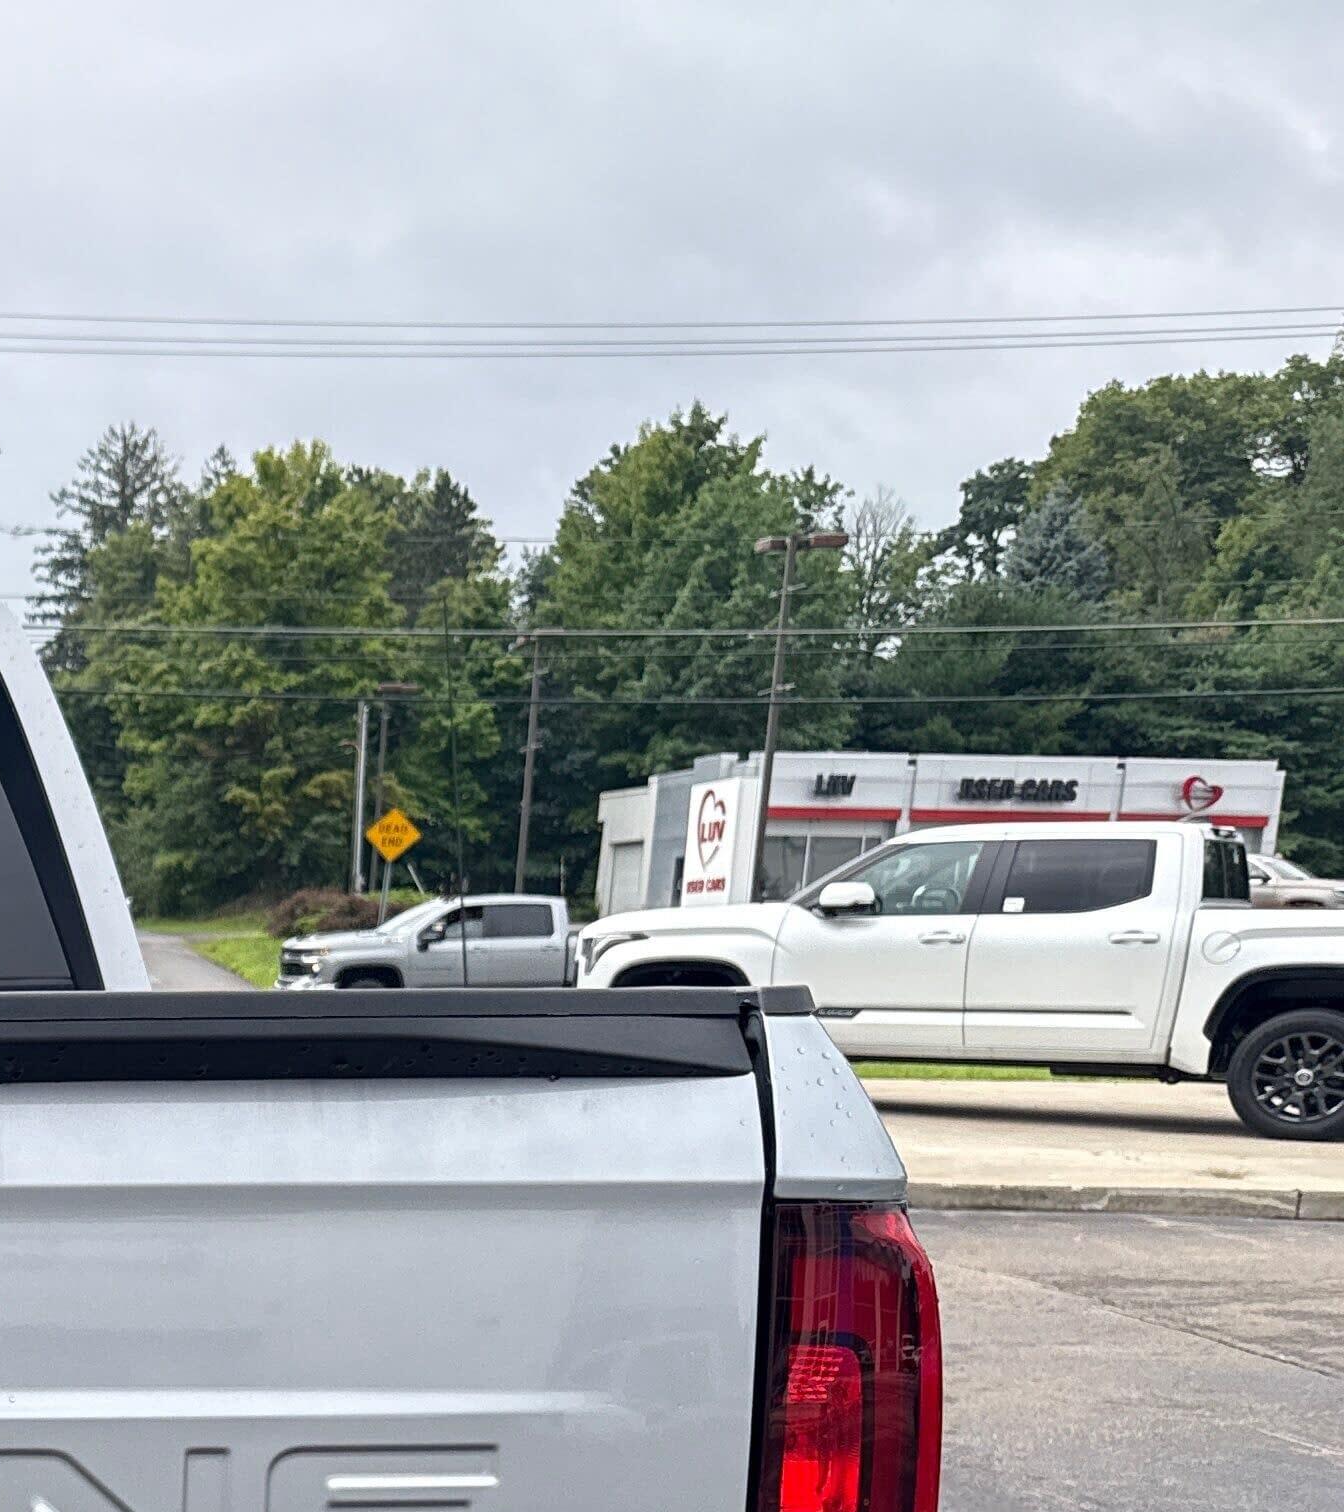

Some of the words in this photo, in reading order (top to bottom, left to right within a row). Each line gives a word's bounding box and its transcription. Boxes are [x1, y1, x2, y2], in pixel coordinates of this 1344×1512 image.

[1018, 779, 1079, 802] CARS
[378, 823, 409, 833] DEAD
[700, 820, 726, 843] LUV
[381, 837, 403, 848] END
